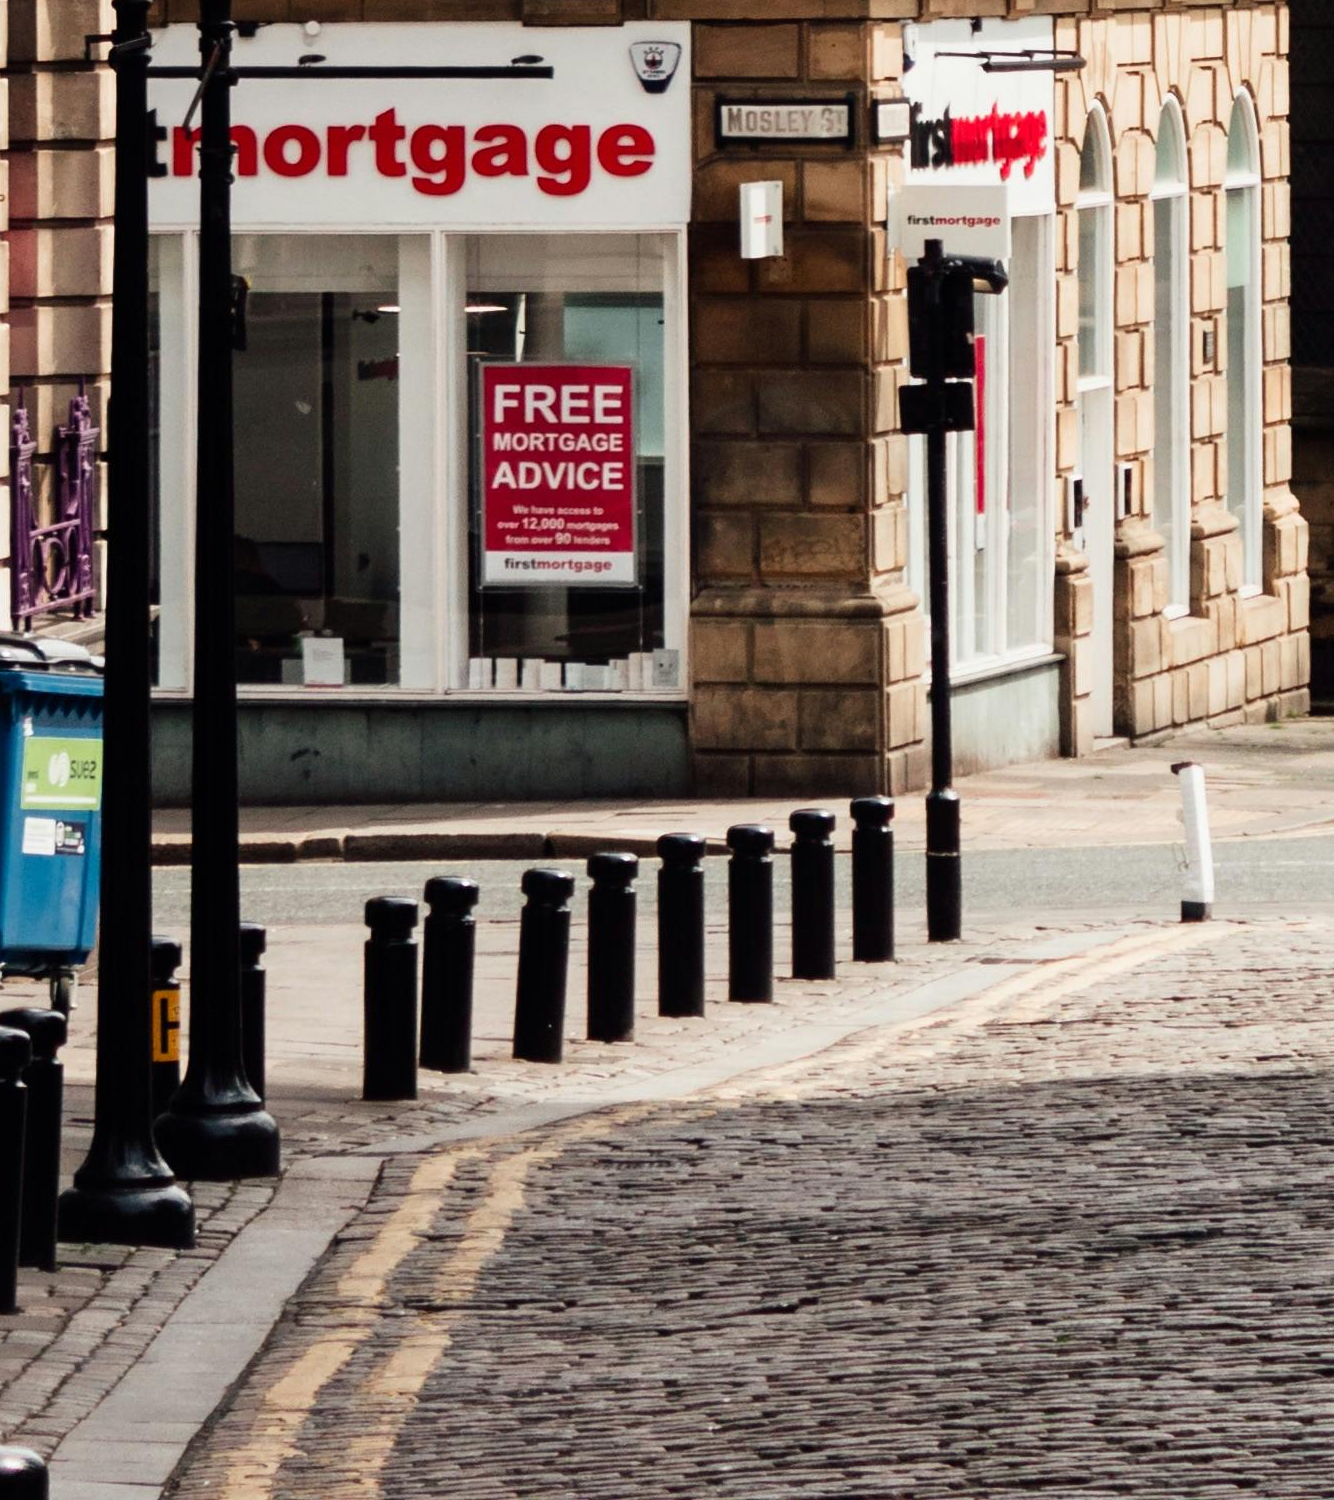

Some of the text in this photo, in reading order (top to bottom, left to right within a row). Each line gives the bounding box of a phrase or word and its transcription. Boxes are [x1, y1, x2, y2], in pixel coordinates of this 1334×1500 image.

[727, 107, 813, 133] MOSLEY
[907, 213, 1001, 228] firstmortgage
[493, 384, 624, 424] FREE
[492, 432, 624, 452] MORTGAGE
[491, 461, 624, 490] ADVICE
[512, 504, 604, 516] We have access to
[497, 518, 620, 532] over 12,000 mortgages
[505, 534, 530, 545] from
[531, 536, 553, 545] over
[573, 534, 611, 545] lenders
[504, 558, 613, 573] firstmortgage
